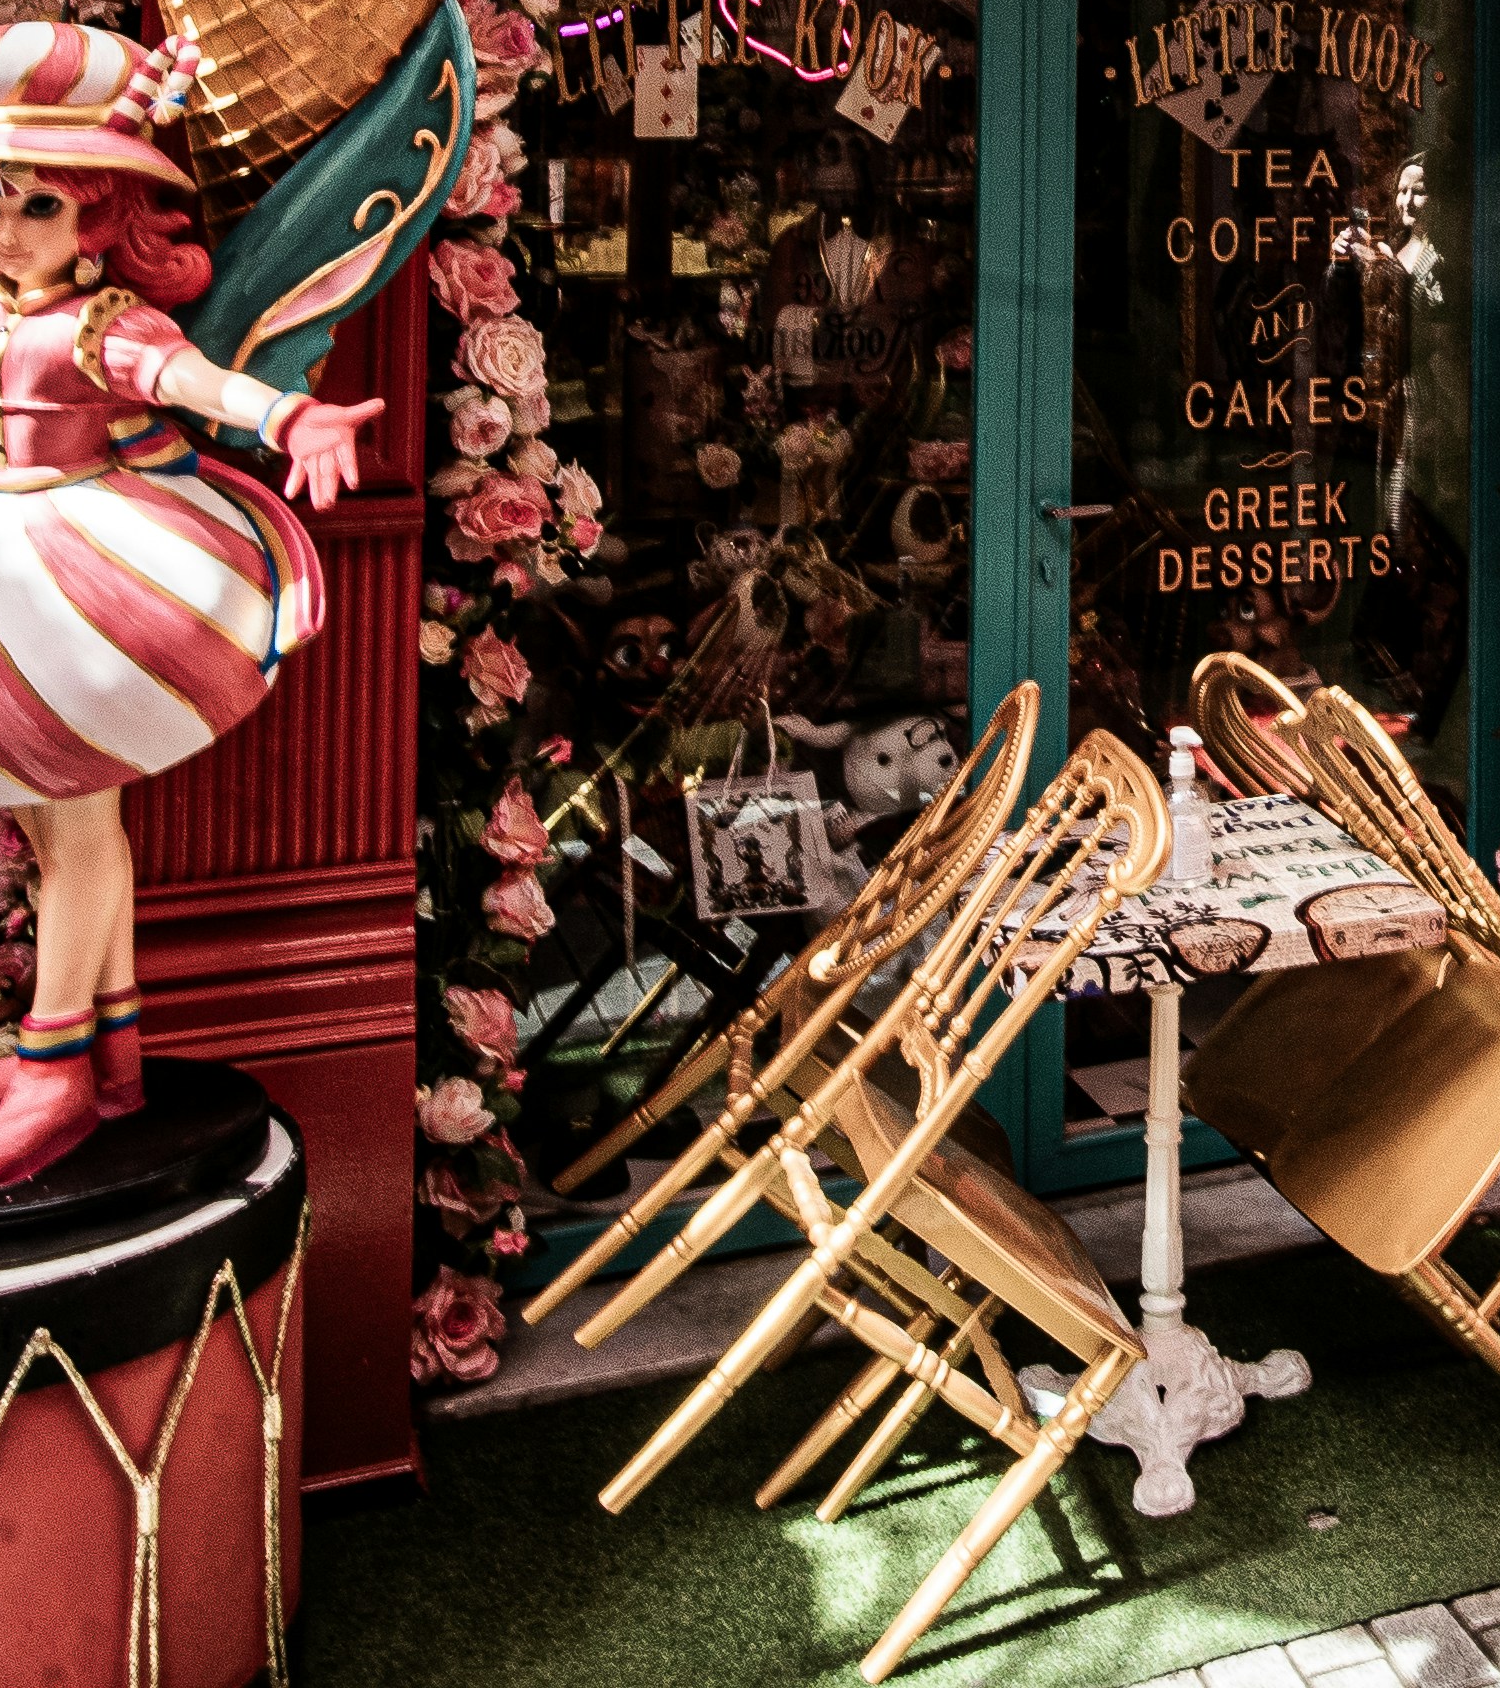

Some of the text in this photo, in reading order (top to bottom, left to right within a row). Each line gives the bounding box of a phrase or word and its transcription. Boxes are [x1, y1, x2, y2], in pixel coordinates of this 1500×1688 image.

[1125, 0, 1436, 110] LITTLE KOOK
[1219, 148, 1339, 190] TEA
[1166, 216, 1387, 263] COFFEE
[1249, 299, 1314, 346] AND
[1184, 375, 1368, 431] CAKES
[1204, 481, 1348, 532] GREEK
[1158, 533, 1391, 592] DESSERTS
